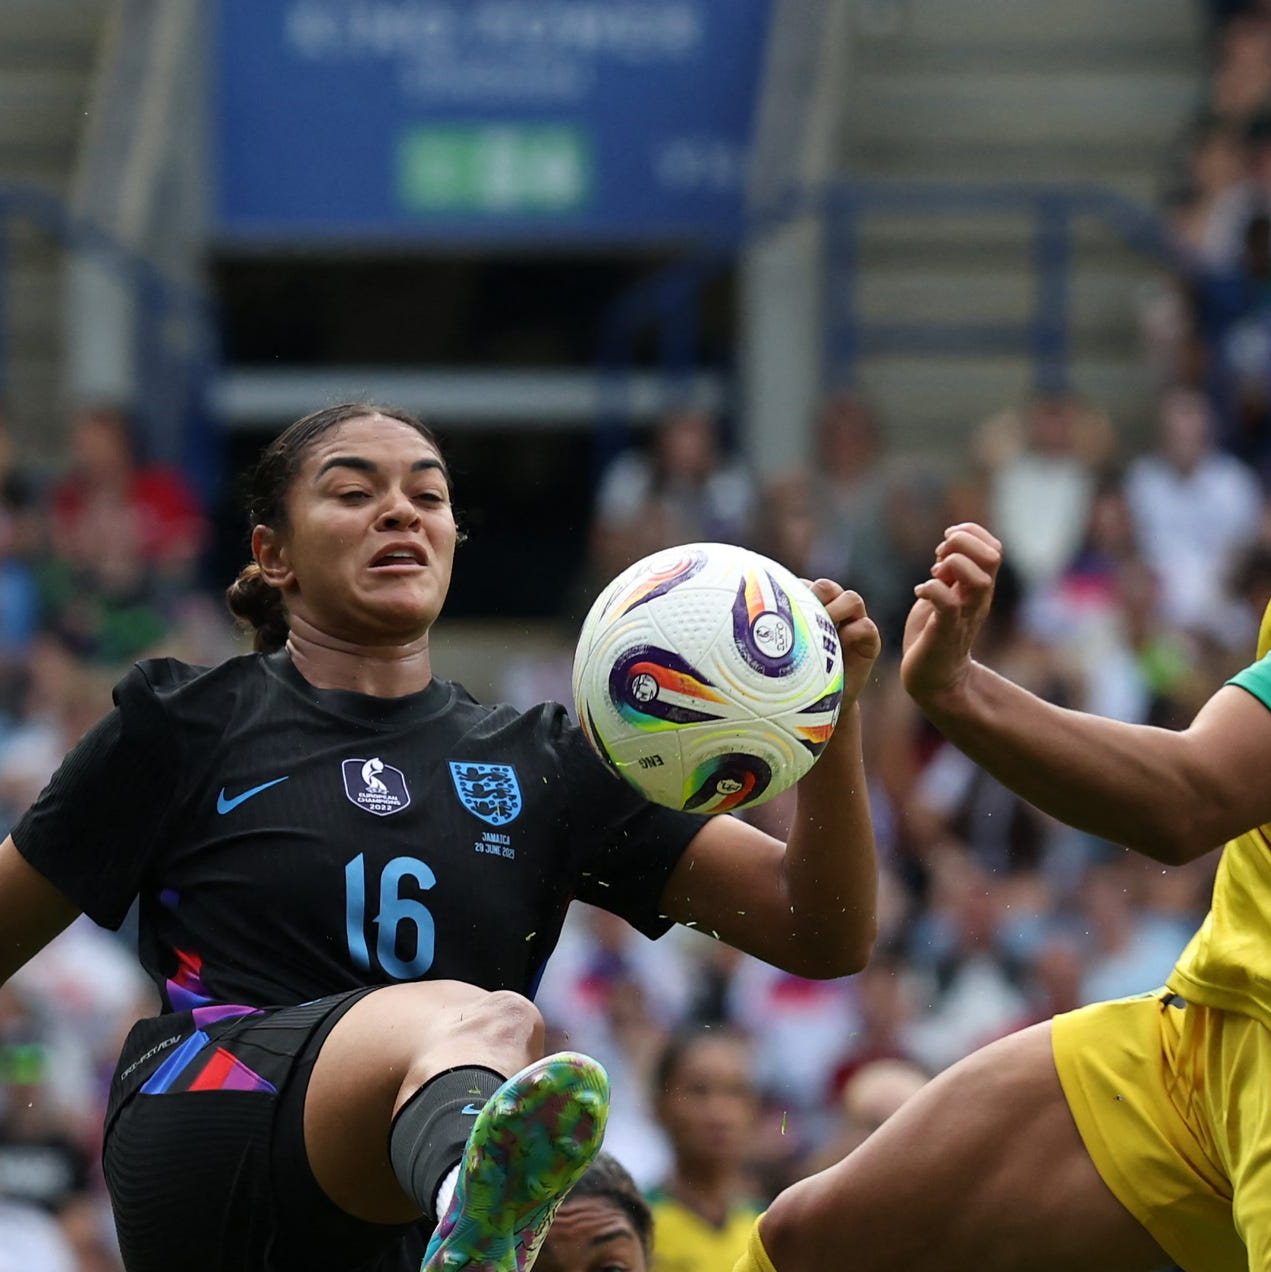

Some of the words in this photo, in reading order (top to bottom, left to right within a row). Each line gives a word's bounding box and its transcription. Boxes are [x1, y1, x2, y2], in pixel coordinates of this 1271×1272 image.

[638, 754, 665, 769] ENG
[357, 797, 401, 806] CHAMPIONS
[358, 792, 398, 801] EUROPEAN
[369, 803, 392, 811] 2022
[481, 832, 510, 845] JAMAICA
[485, 843, 501, 856] JUNE
[345, 852, 437, 979] 16
